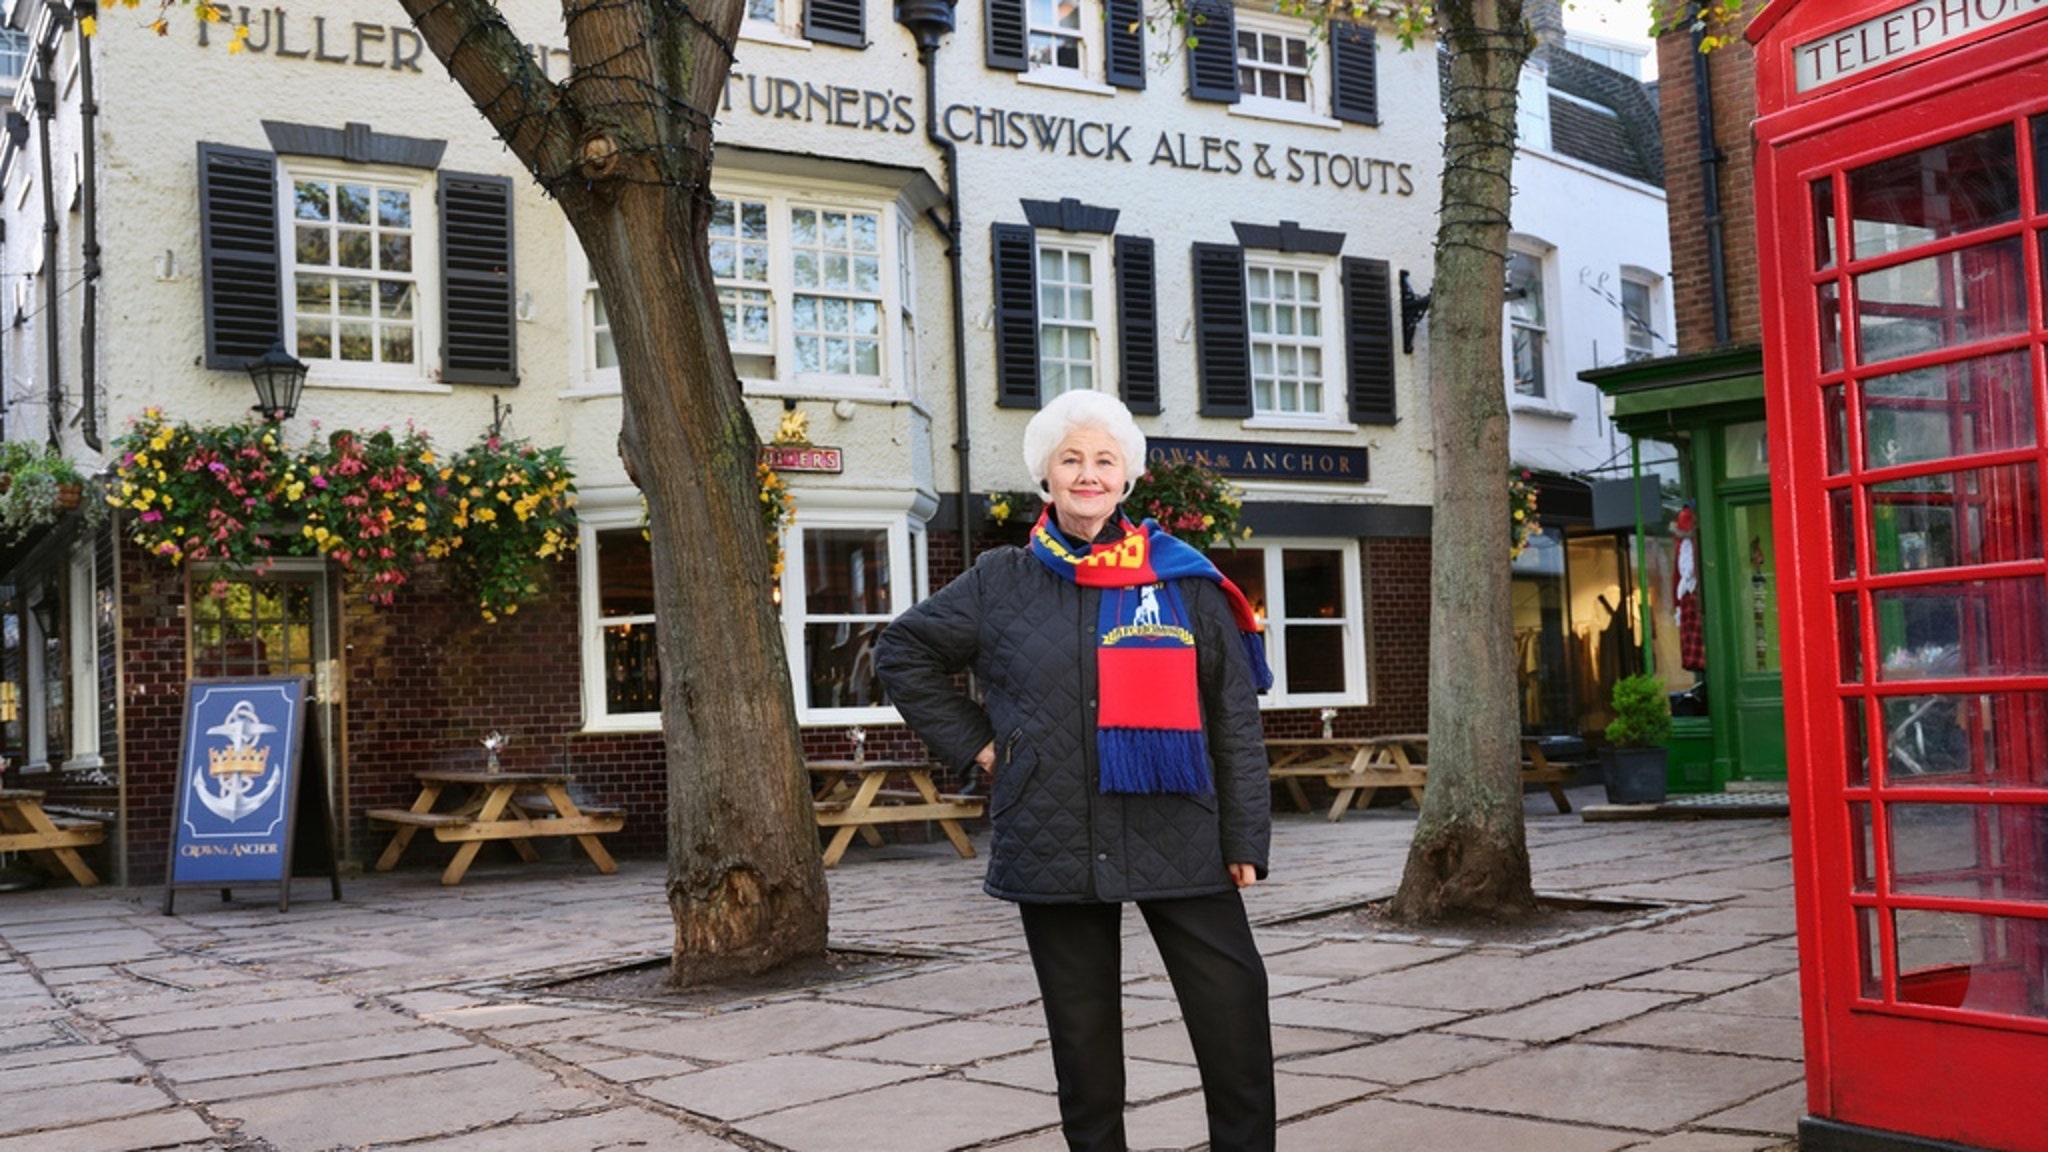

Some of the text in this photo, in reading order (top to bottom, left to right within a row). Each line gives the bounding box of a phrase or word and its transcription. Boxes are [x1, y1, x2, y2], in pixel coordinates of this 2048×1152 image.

[1804, 0, 2042, 81] TELEPHO
[198, 2, 1415, 197] FULLER TURNER'S CHISWICK ALES & STOUTS
[1149, 446, 1212, 467] OWN
[1242, 450, 1351, 473] ANCHOR
[230, 843, 278, 857] ANCHOR
